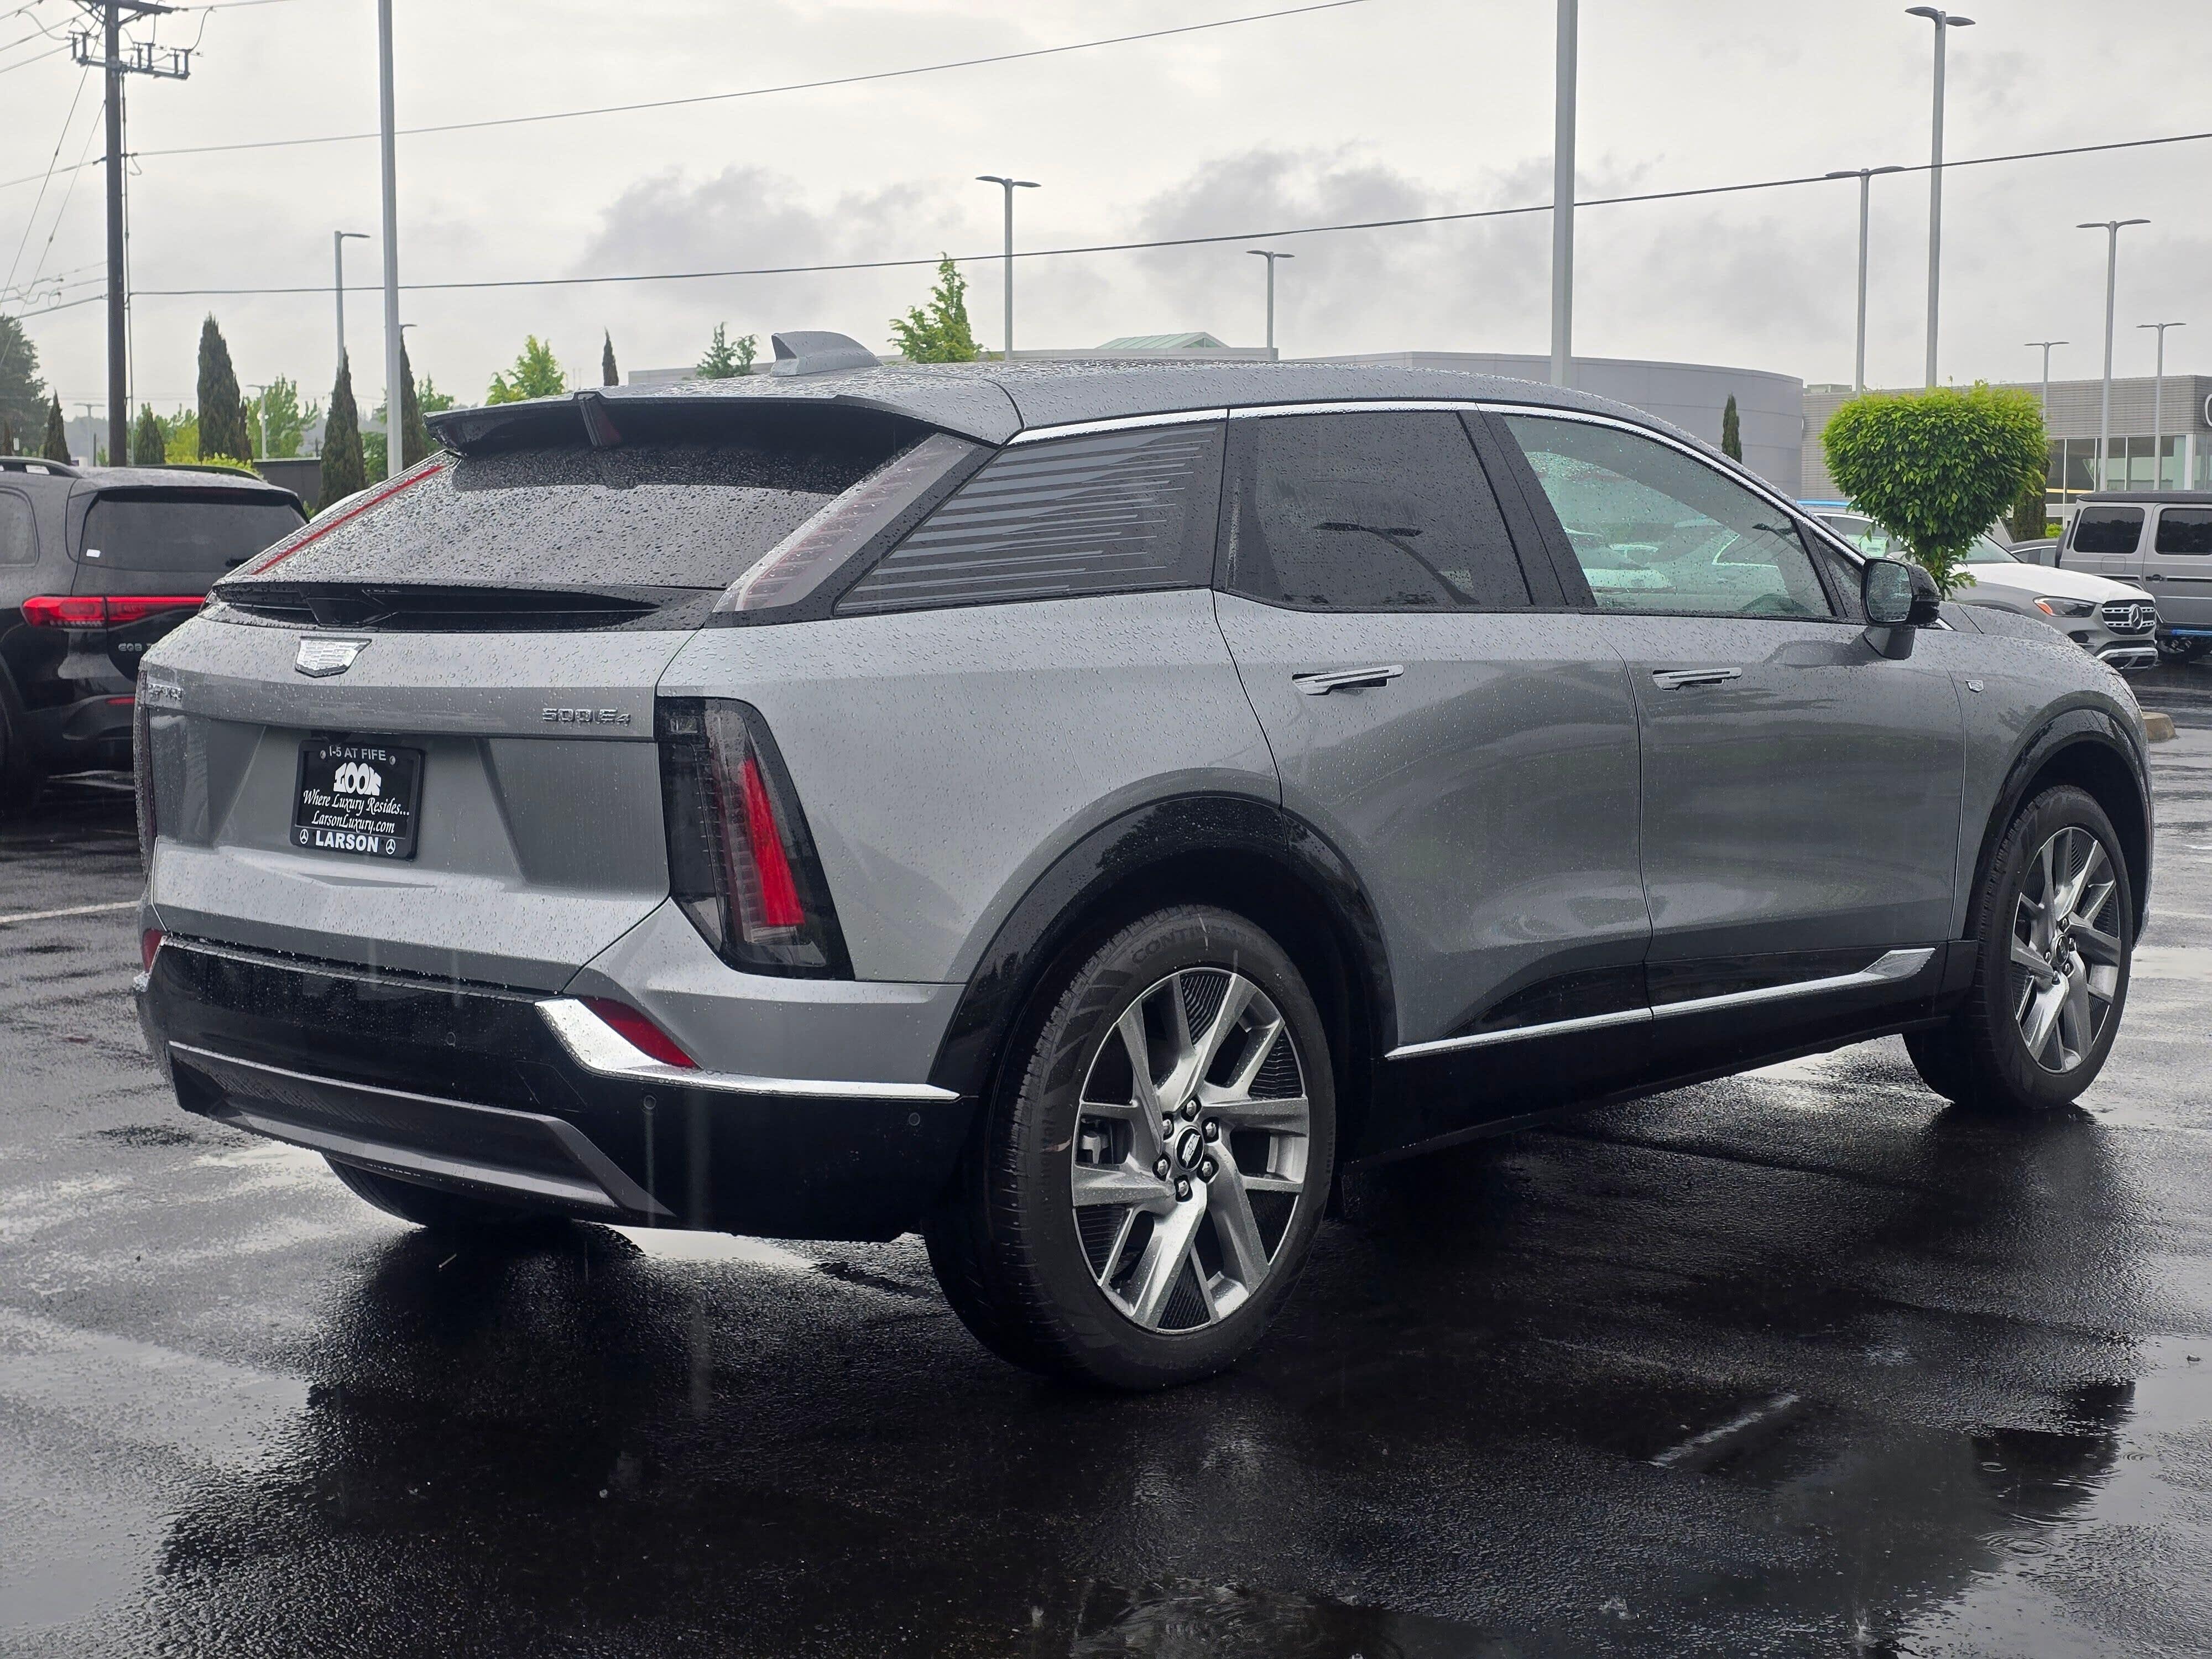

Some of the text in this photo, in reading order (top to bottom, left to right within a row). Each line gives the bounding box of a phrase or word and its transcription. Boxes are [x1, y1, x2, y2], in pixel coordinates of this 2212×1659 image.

[542, 708, 592, 722] 500
[329, 745, 386, 761] I-5 AT FIFE
[303, 789, 410, 816] Where Luxury Resides...
[311, 810, 395, 834] LarsonLuxury.com
[315, 830, 379, 853] LARSON
